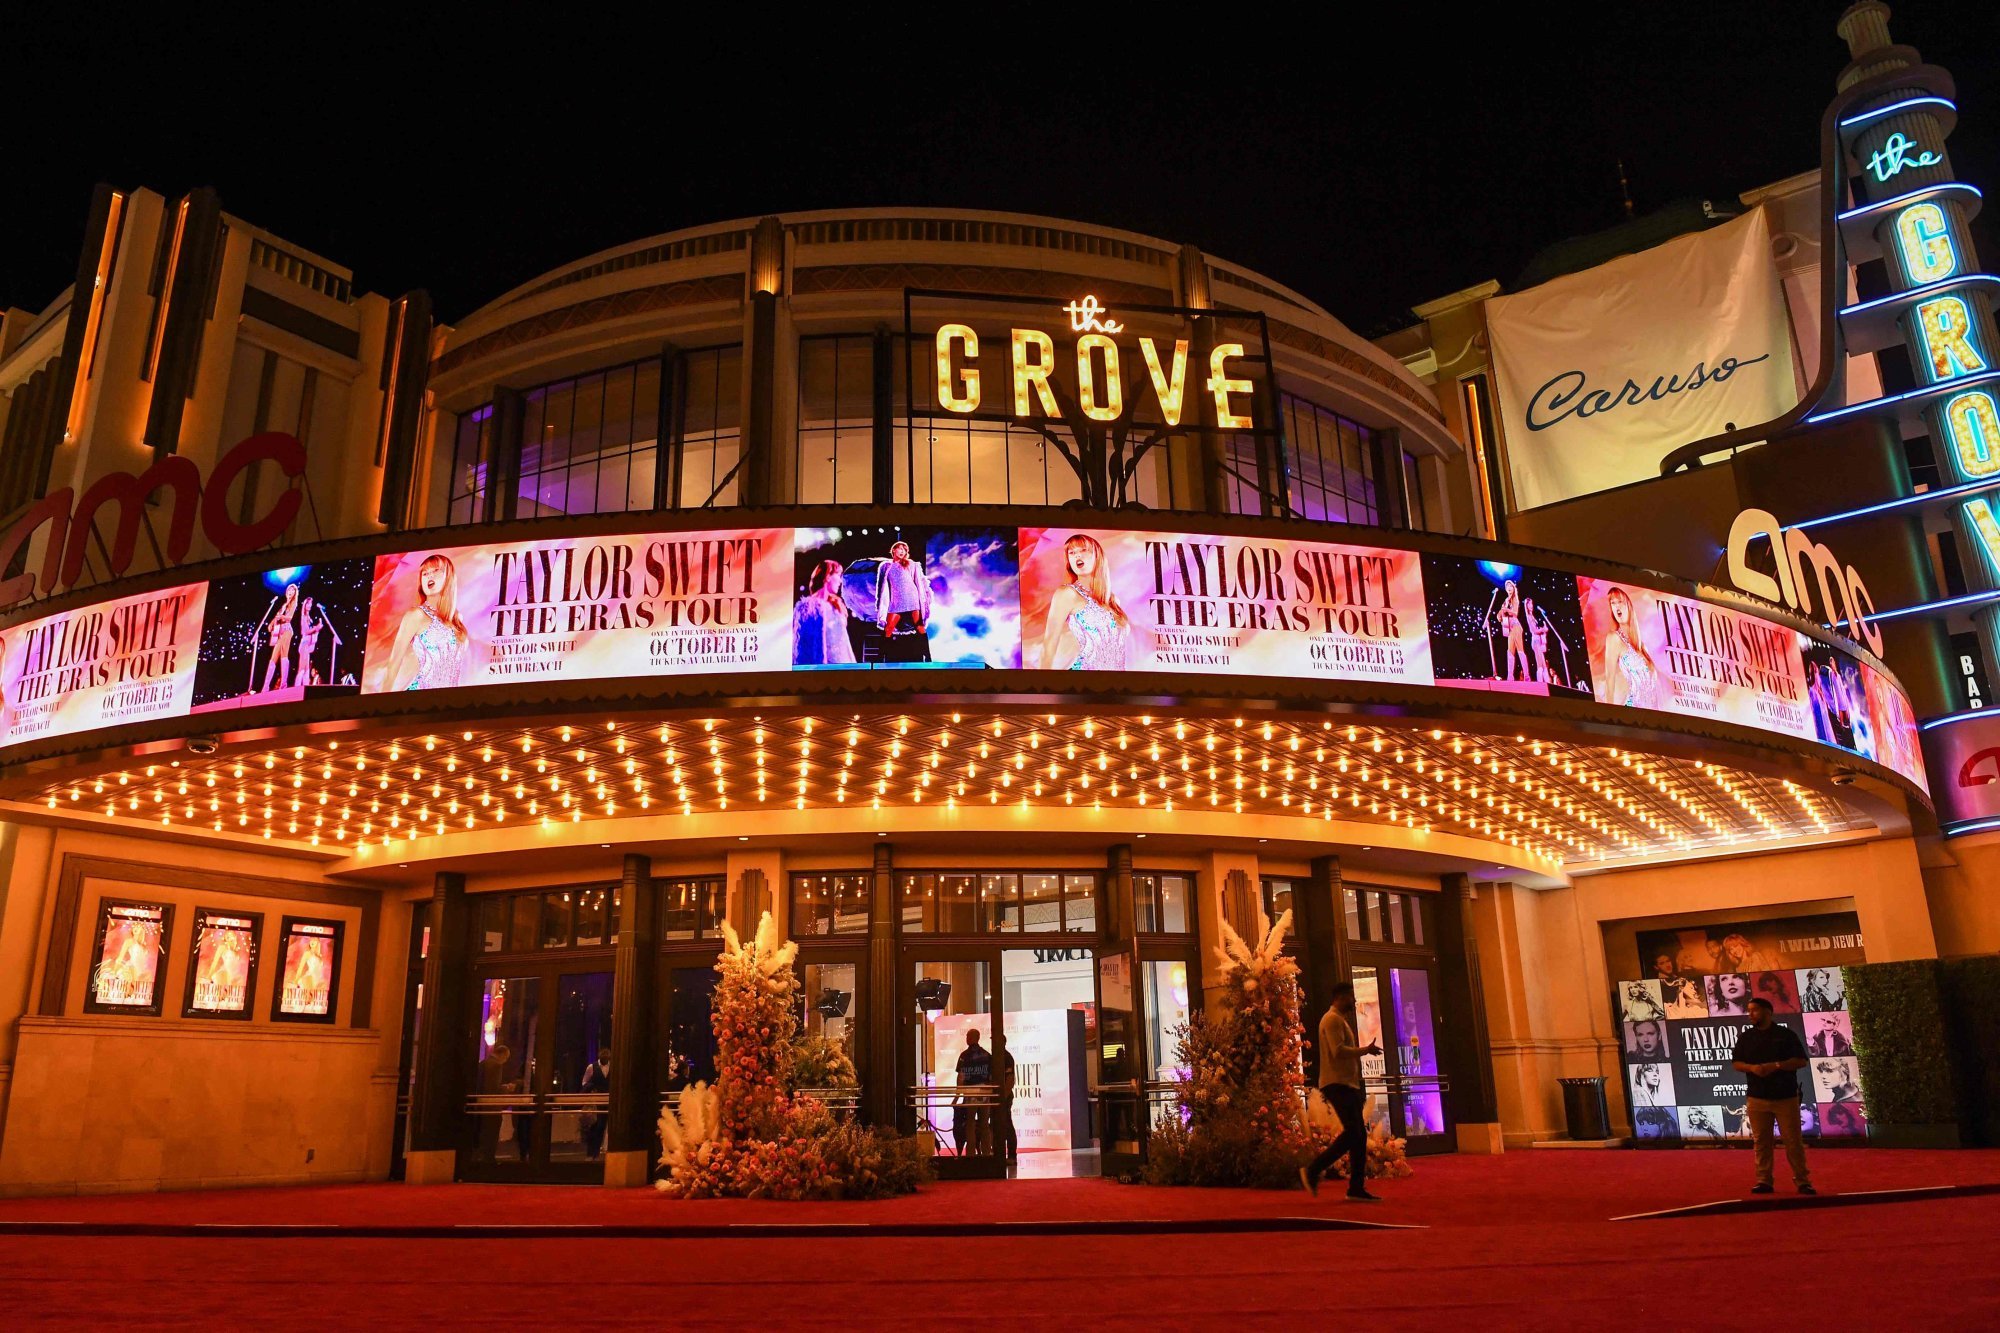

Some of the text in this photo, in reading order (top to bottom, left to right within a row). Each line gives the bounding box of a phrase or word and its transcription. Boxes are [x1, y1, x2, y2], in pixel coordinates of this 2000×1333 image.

[1865, 132, 1943, 182] the
[1062, 294, 1124, 333] the
[935, 323, 1254, 429] GROVE
[1525, 353, 1771, 432] Caruso
[494, 538, 763, 607] TAYLOR SWIFT
[1145, 541, 1394, 609] TAYLOR SWIFT
[1727, 508, 1884, 659] amc
[490, 597, 761, 637] THE ERAS TOUR
[1150, 598, 1401, 639] THE ERAS TOUR
[21, 595, 187, 677] TAYLOR SWIFT
[491, 640, 577, 656] TAYLOR SWIFT
[650, 635, 759, 656] OCTOBER 13
[1155, 633, 1241, 647] TAYLOR SWIFT
[1656, 599, 1792, 676] TAYLOR SWIFT
[650, 654, 758, 666] TICKETS AVAILABLE NOW
[1156, 653, 1230, 665] SAM WRENCH
[1310, 643, 1404, 666] OCTOBER 13
[17, 649, 177, 703] THE ERAS TOUR
[489, 661, 563, 675] SAM WRENCH
[1313, 662, 1404, 675] TICKETS AVAILABLE NOW
[1665, 649, 1707, 680] THE
[1708, 657, 1755, 690] ERAS
[1755, 669, 1798, 701] TOUR
[40, 702, 60, 713] SWIFT
[102, 685, 173, 710] OCTOBER 13
[158, 702, 171, 710] NOW
[1756, 699, 1794, 721] OCTOBER
[9, 725, 24, 737] SAM
[1787, 936, 1831, 953] WILD
[1832, 934, 1855, 949] NEW
[1856, 933, 1865, 947] R
[1684, 1048, 1733, 1061] THE ER
